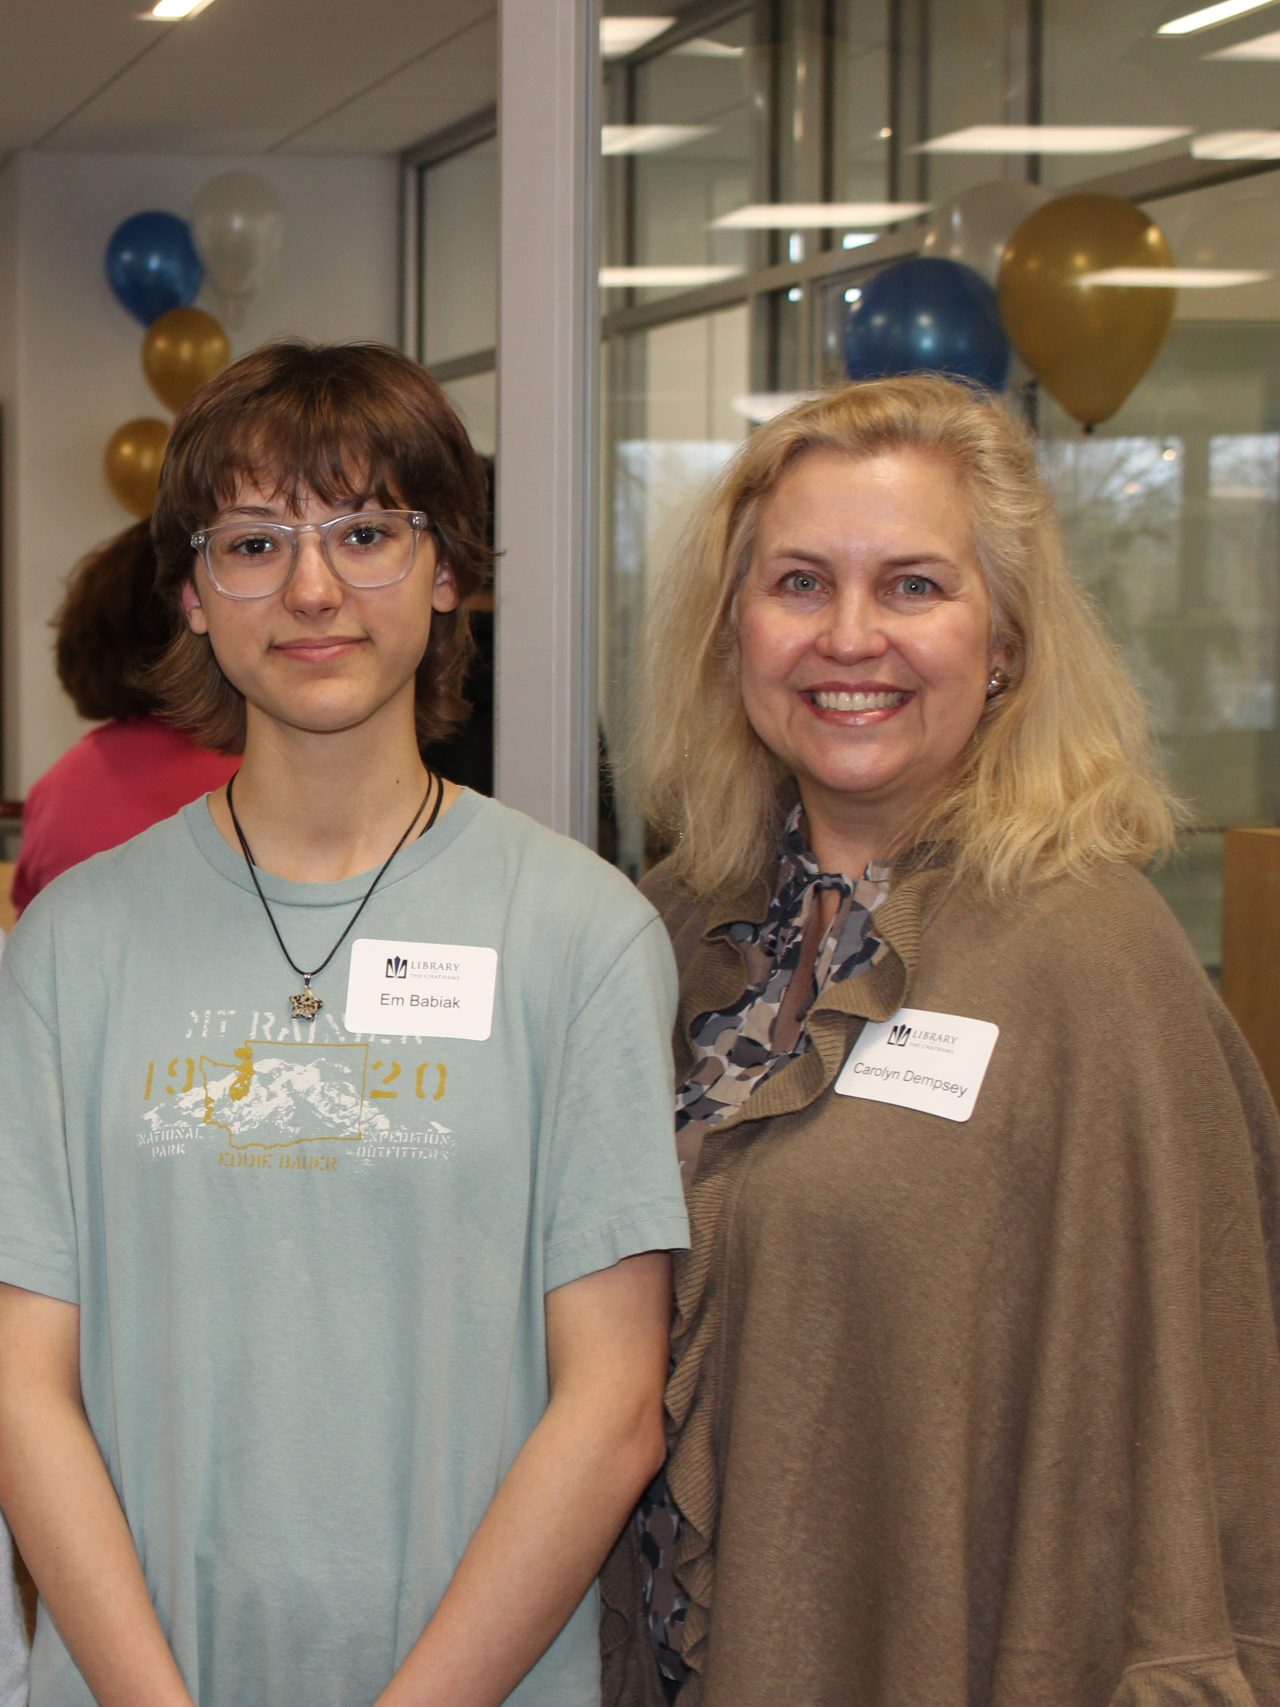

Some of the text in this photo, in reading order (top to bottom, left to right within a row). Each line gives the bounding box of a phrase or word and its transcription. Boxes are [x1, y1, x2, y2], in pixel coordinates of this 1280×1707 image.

[411, 961, 460, 972] LIBRARY
[380, 993, 461, 1009] Em Babiak
[912, 1030, 959, 1045] LIBRARY
[370, 1060, 447, 1101] 20
[853, 1062, 968, 1098] Carolyn Dempsey
[136, 1127, 203, 1147] NATIONAL
[151, 1143, 186, 1160] PARK
[218, 1152, 338, 1171] EDDIE BAUER
